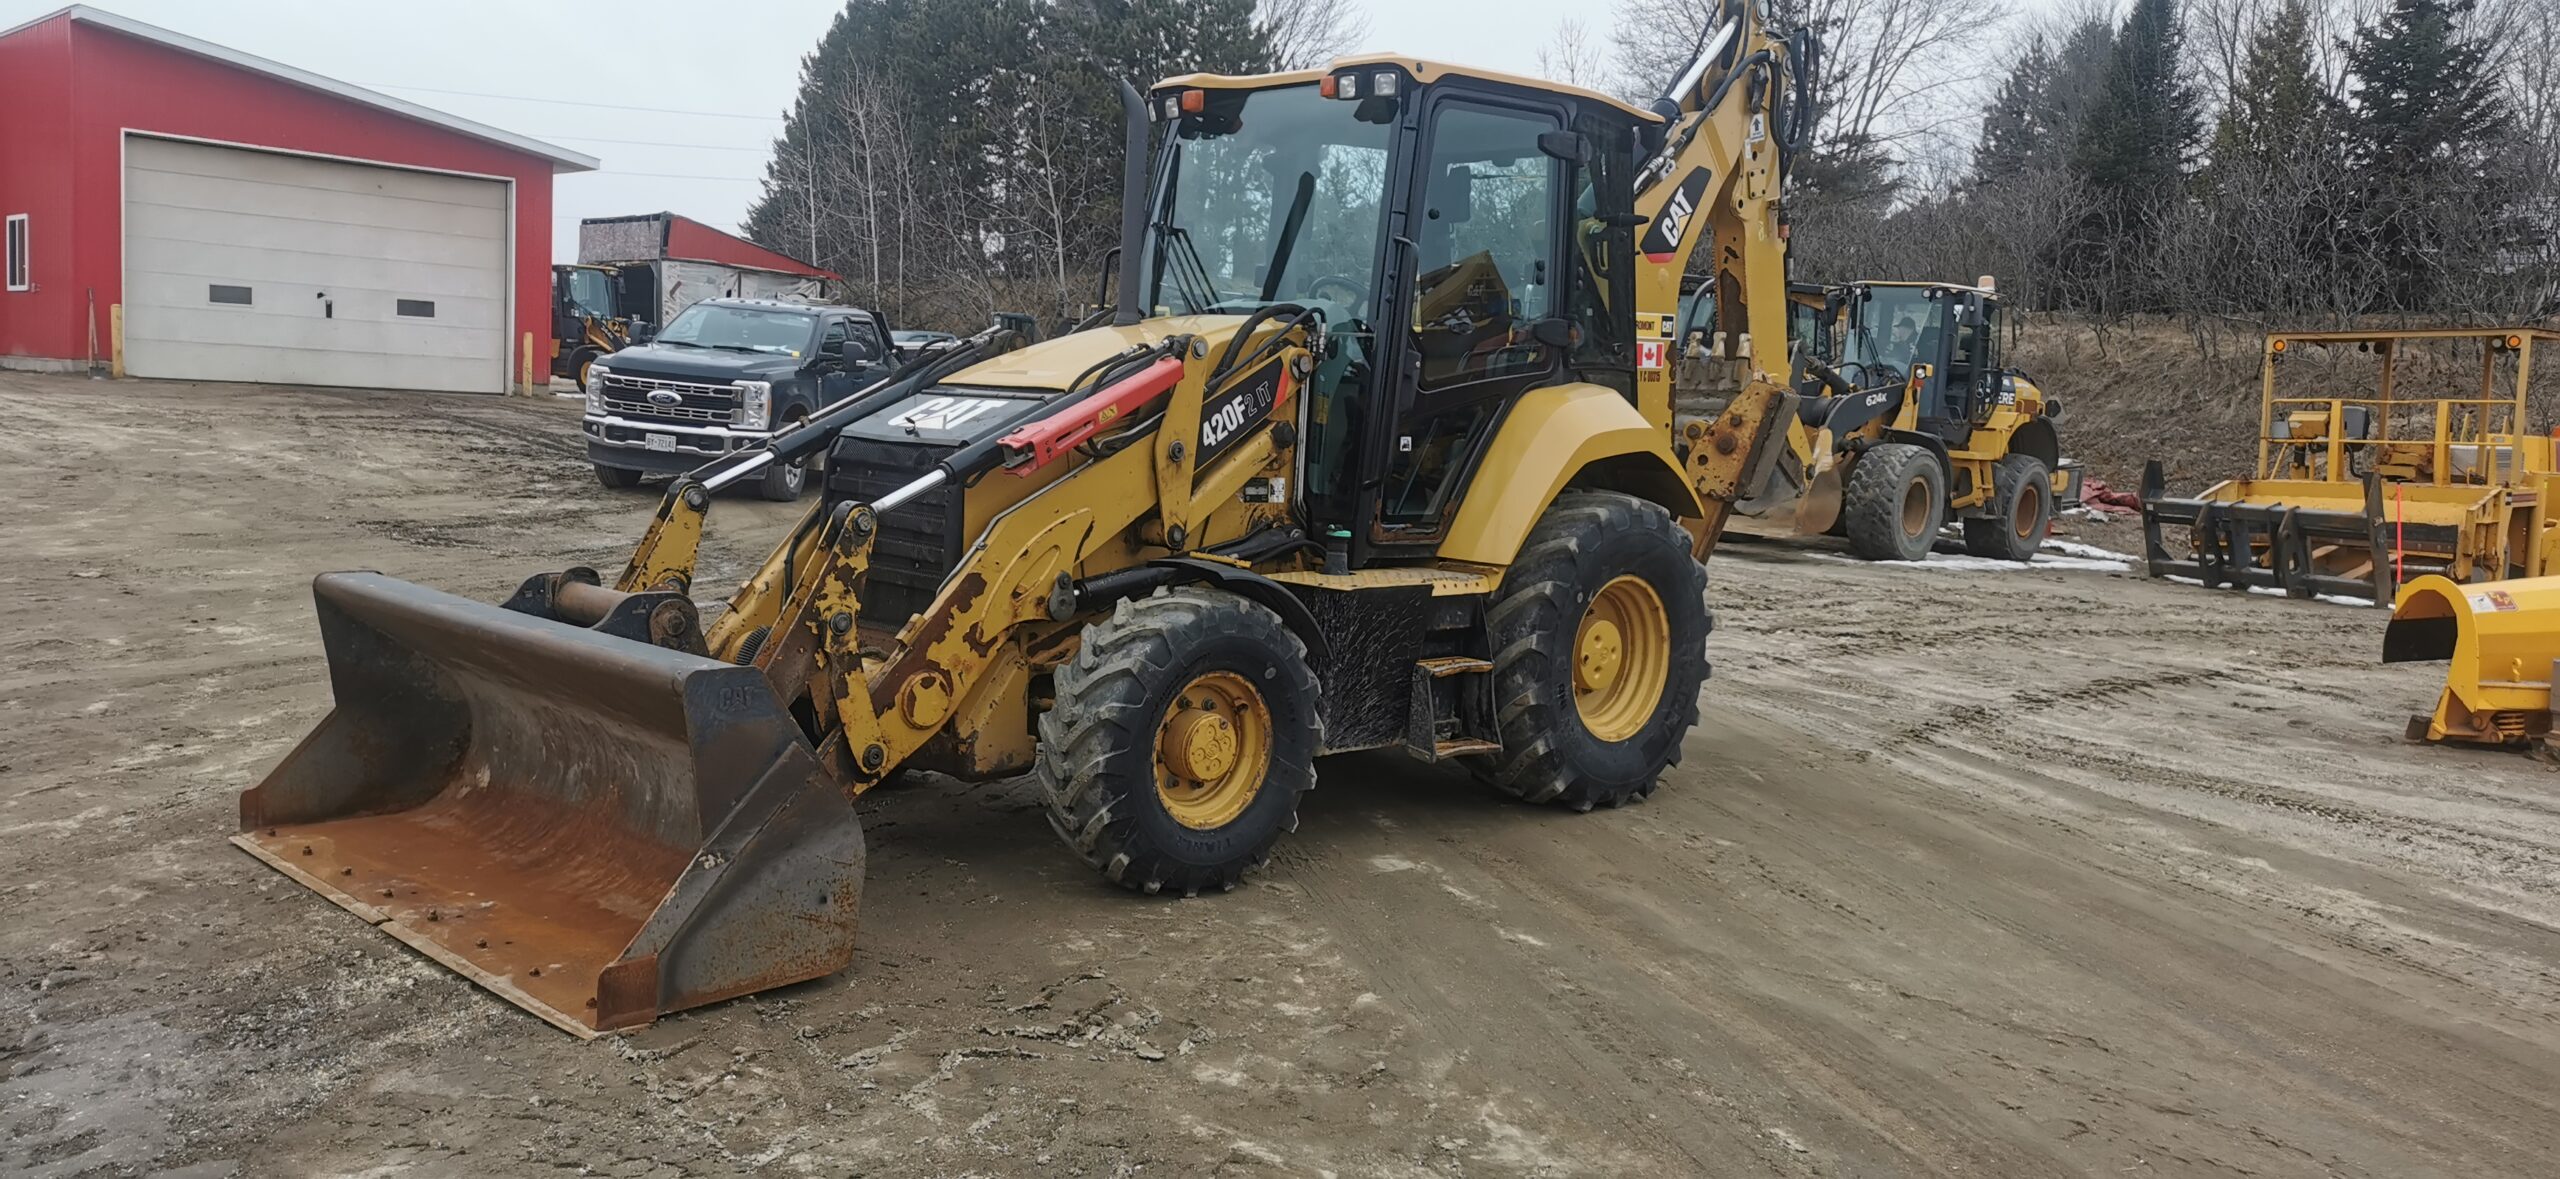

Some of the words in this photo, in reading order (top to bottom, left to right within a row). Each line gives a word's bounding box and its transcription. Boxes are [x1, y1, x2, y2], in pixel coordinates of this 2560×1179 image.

[1661, 186, 1693, 247] CAT
[888, 397, 1010, 430] CAT
[719, 685, 755, 712] CAT
